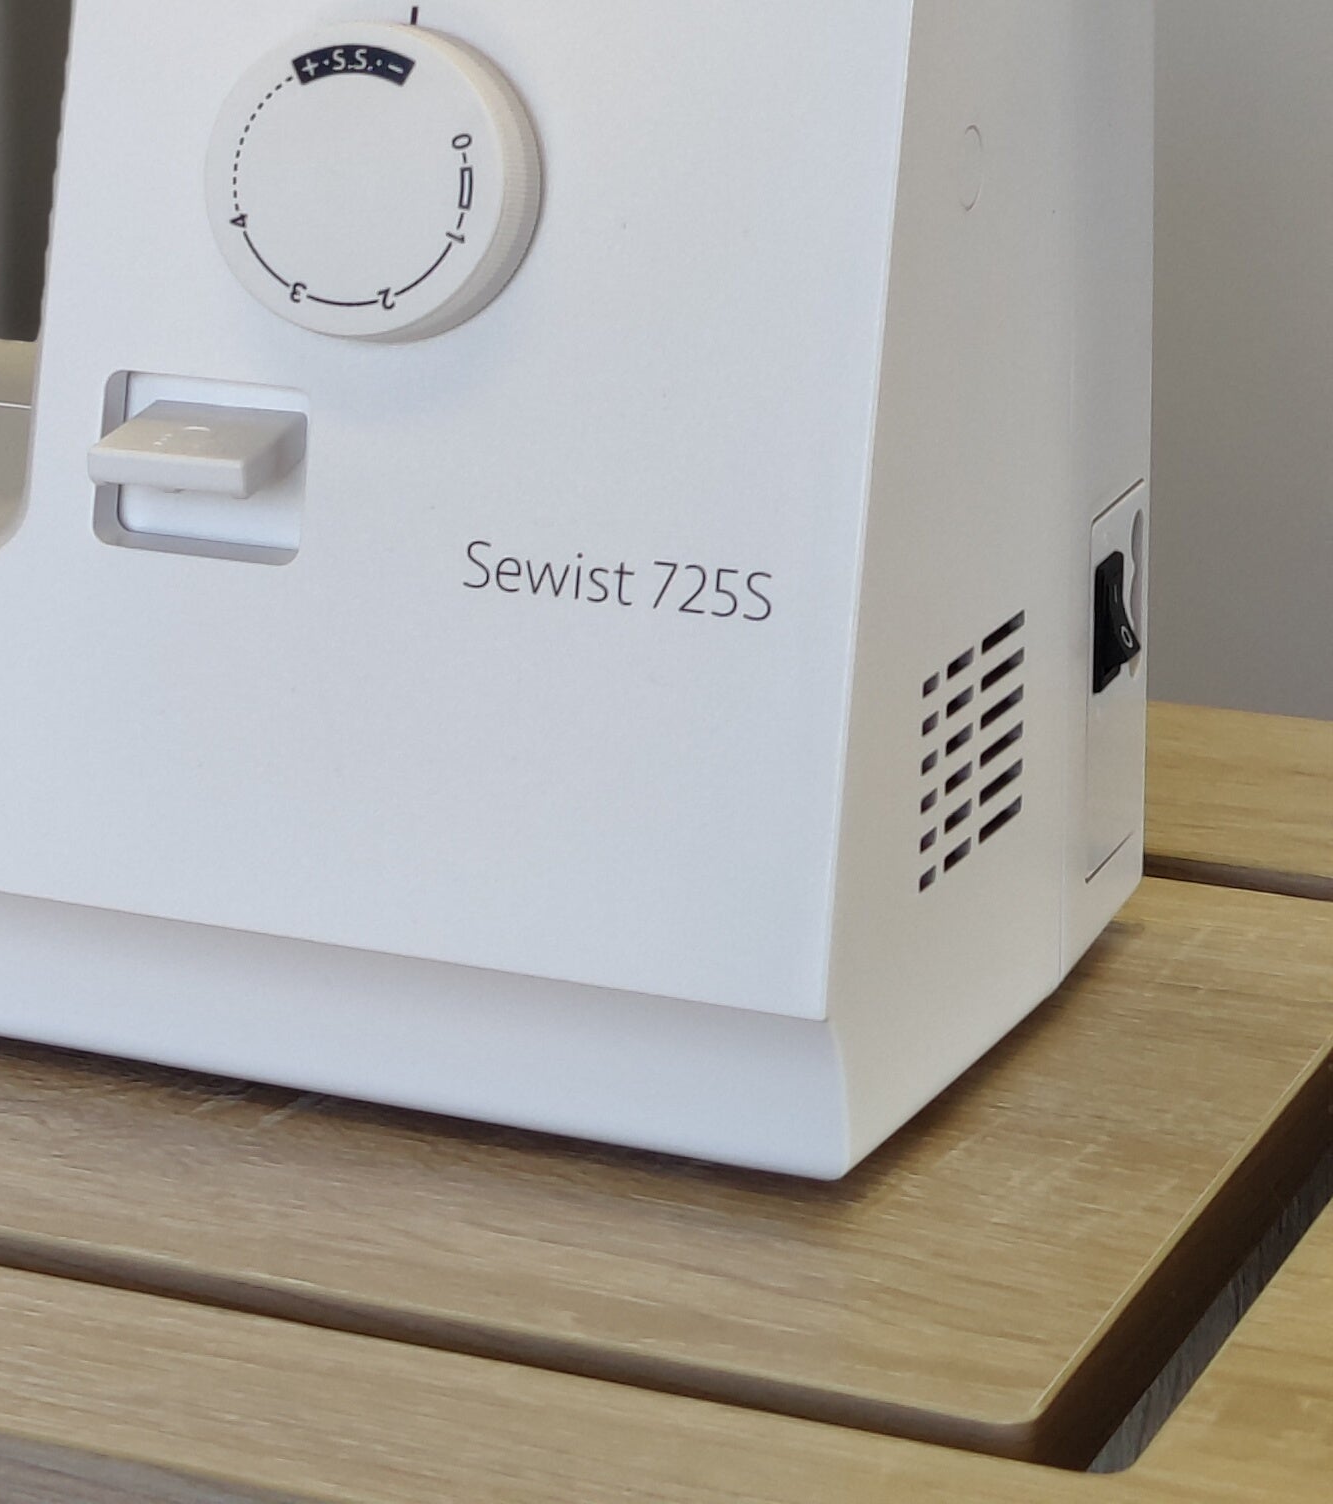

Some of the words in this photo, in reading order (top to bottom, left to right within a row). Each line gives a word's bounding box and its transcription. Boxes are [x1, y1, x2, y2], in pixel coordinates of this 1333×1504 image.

[452, 134, 472, 150] 0
[445, 232, 465, 245] 1
[290, 282, 307, 303] 3
[379, 288, 395, 310] 2
[463, 540, 635, 606] Sewist
[653, 561, 772, 621] 725S
